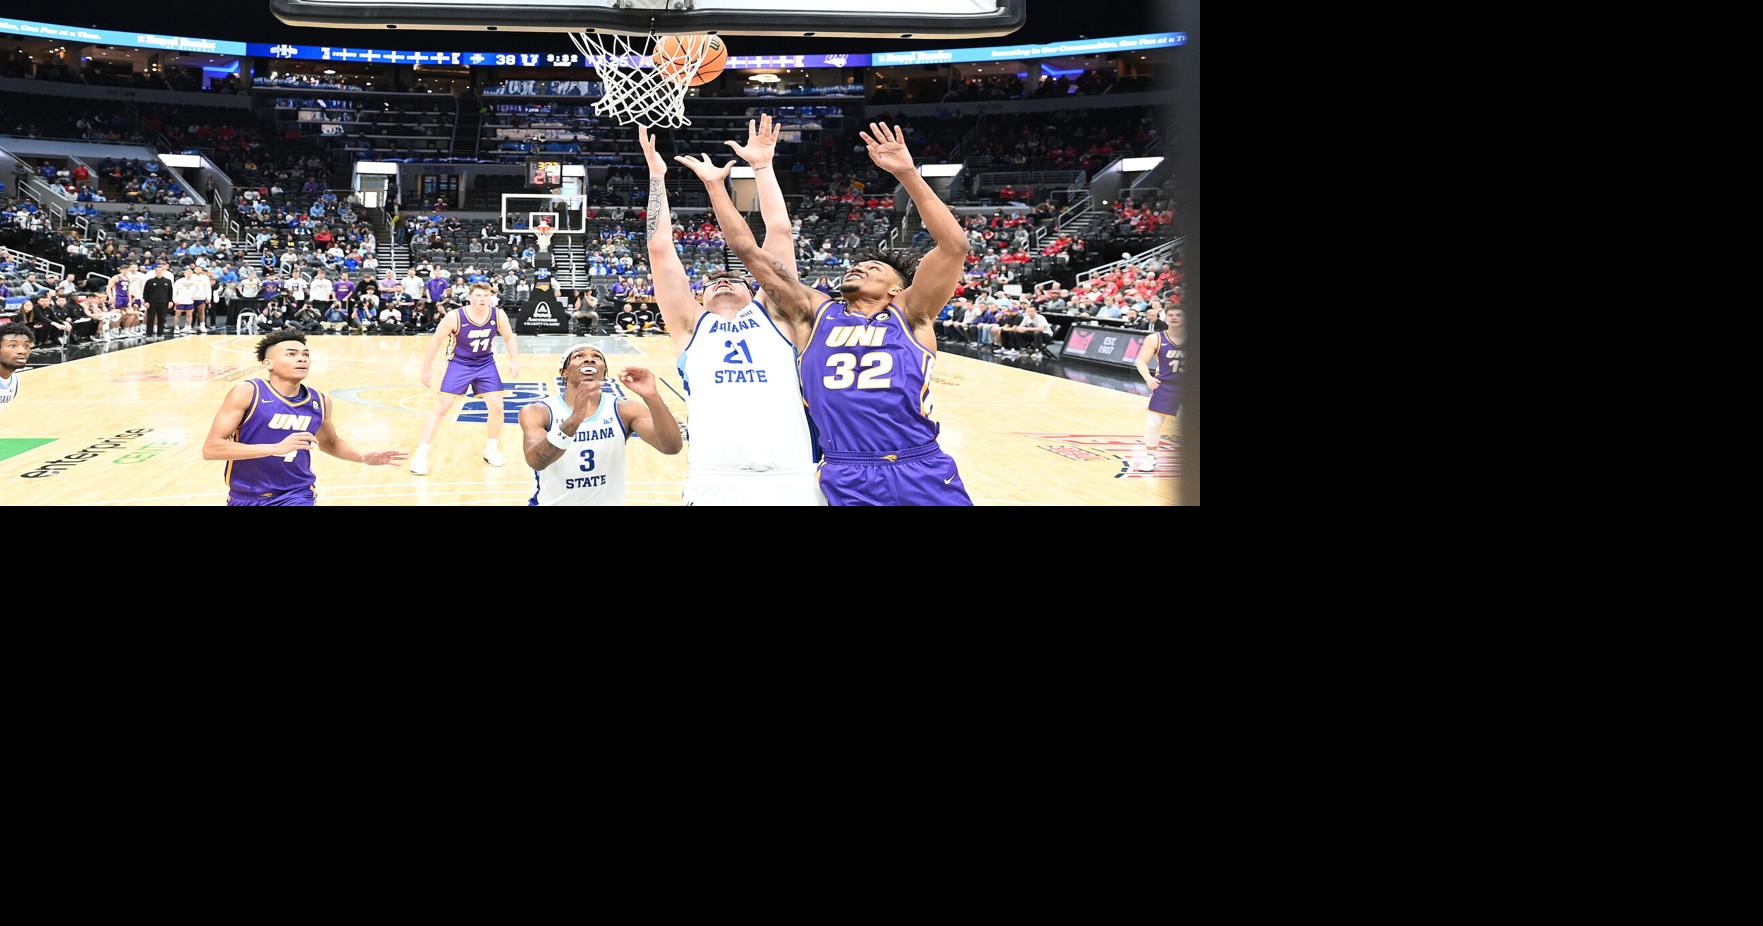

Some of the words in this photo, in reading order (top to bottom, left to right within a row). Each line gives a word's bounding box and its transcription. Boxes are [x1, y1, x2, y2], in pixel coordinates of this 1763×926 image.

[495, 54, 516, 66] 38
[825, 325, 888, 347] UNI
[469, 338, 490, 353] 11
[723, 339, 753, 364] 21
[1165, 350, 1184, 360] UN
[714, 369, 768, 384] STATE
[822, 351, 894, 390] 32
[267, 412, 312, 431] UNI
[573, 426, 615, 443] DIANA
[20, 427, 154, 479] enterprise
[579, 448, 595, 472] 3
[565, 474, 607, 490] STATE
